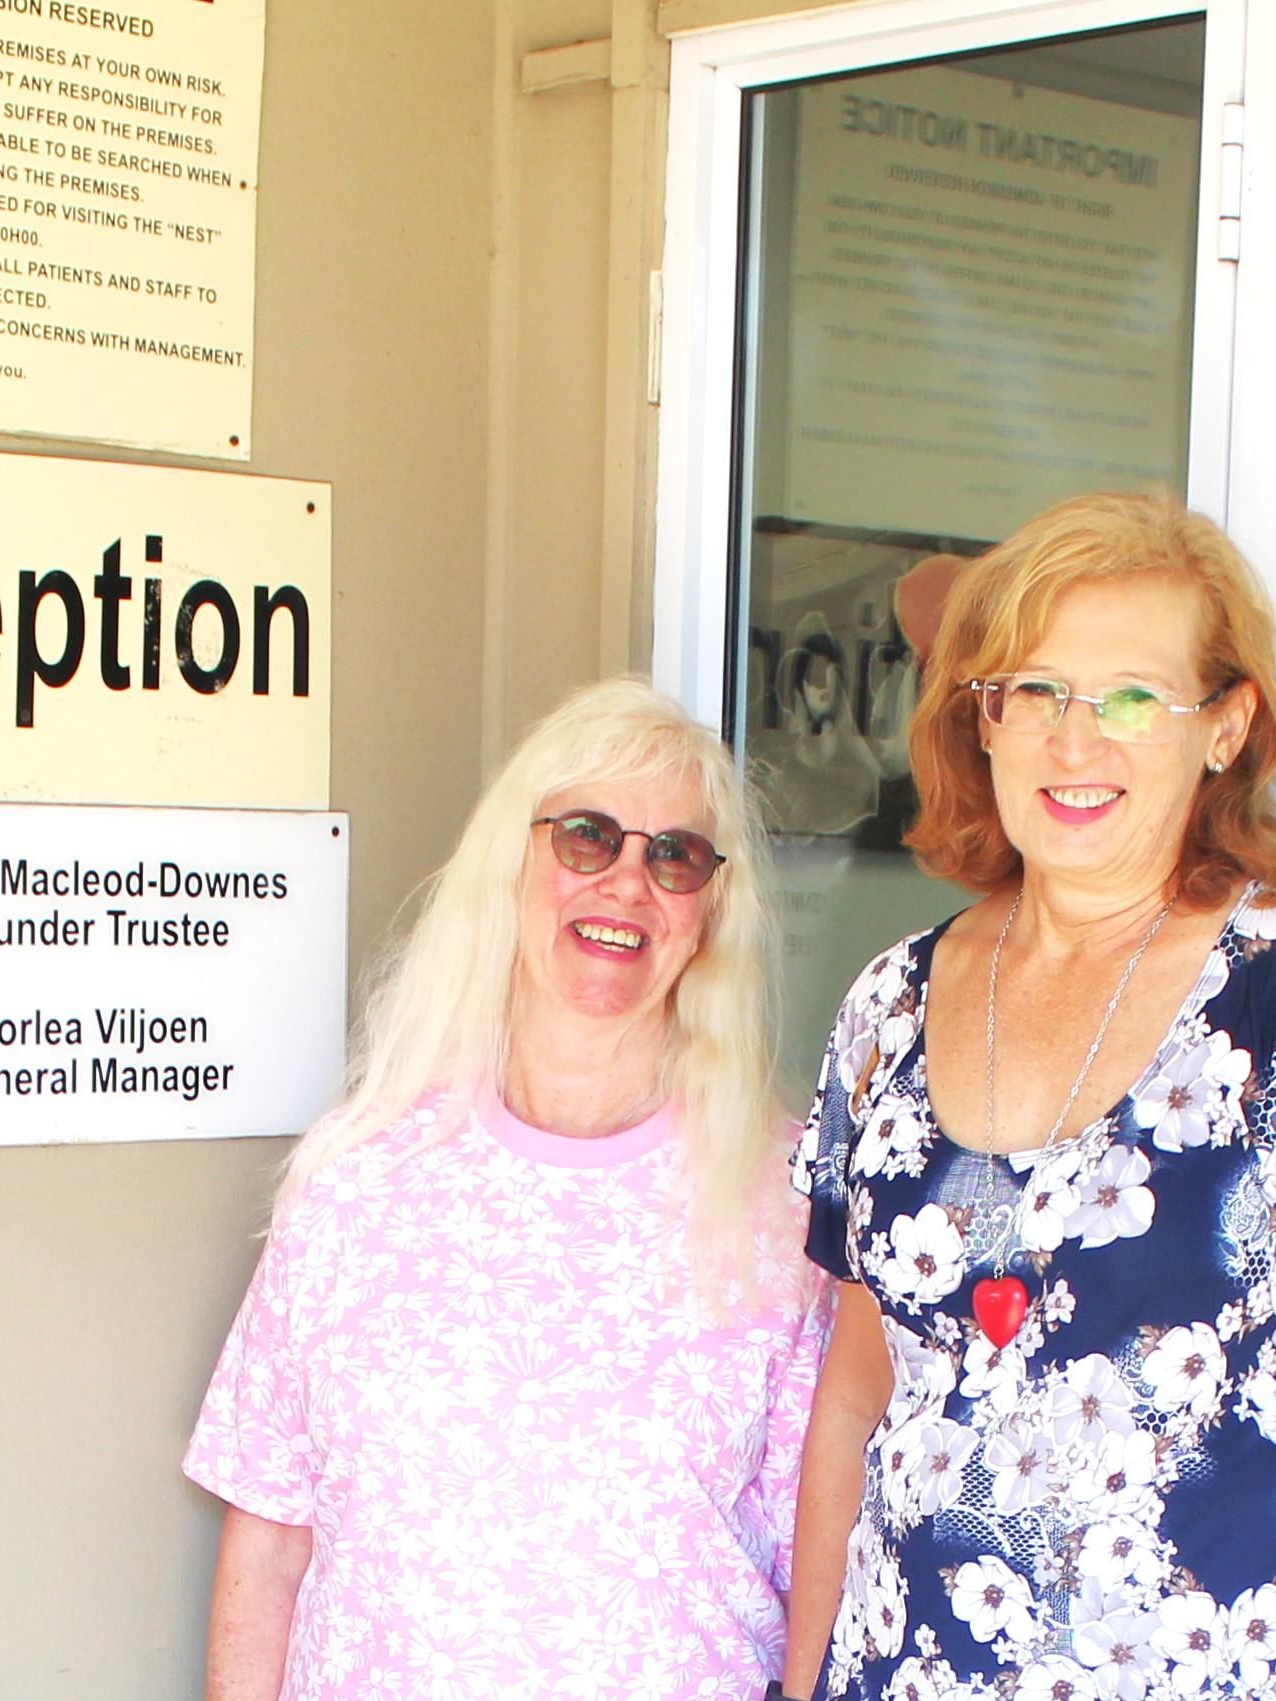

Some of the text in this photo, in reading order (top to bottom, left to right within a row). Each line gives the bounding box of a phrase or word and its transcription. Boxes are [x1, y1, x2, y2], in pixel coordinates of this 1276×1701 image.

[49, 1, 154, 38] RESERVED
[71, 53, 91, 70] AT
[96, 57, 140, 80] YOUR
[145, 67, 181, 88] OWN
[187, 75, 225, 96] RISK.
[19, 75, 52, 94] ANY
[58, 81, 186, 118] RESPONSIBILITY
[192, 106, 222, 126] FOR
[4, 103, 67, 128] SUFFER
[73, 115, 96, 133] ON
[101, 120, 131, 139] THE
[136, 126, 215, 155] PREMISES.
[45, 140, 66, 158] TO
[71, 145, 91, 163] BE
[97, 150, 182, 178] SEARCHED
[187, 166, 231, 187] WHEN
[24, 168, 54, 187] THE
[60, 174, 142, 203] PREMISES.
[24, 199, 57, 218] FOR
[62, 205, 128, 230] VISITING
[133, 216, 162, 236] THE
[28, 261, 103, 287] PATIENTS
[108, 274, 140, 292] AND
[146, 279, 192, 299] STAFF
[197, 287, 217, 304] TO
[91, 331, 129, 351] WITH
[135, 337, 245, 368] MANAGEMENT.
[2, 859, 287, 899] Macleod-Downes
[107, 910, 228, 946] Trustee
[96, 1009, 206, 1053] Viljoen
[92, 1058, 233, 1101] Manager
